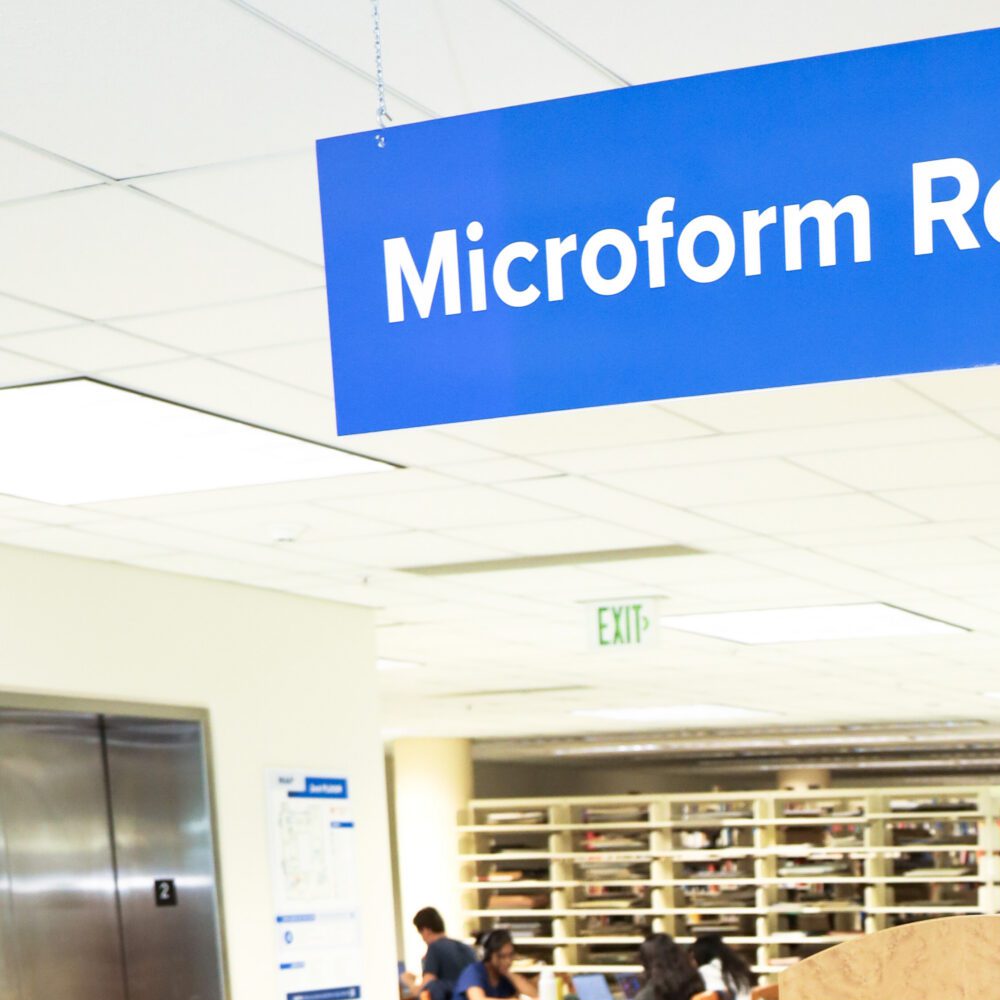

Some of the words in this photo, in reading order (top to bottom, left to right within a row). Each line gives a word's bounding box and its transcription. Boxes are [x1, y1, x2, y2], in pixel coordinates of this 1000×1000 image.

[383, 195, 872, 323] Microform
[597, 604, 643, 646] EXIT
[159, 882, 170, 899] 2
